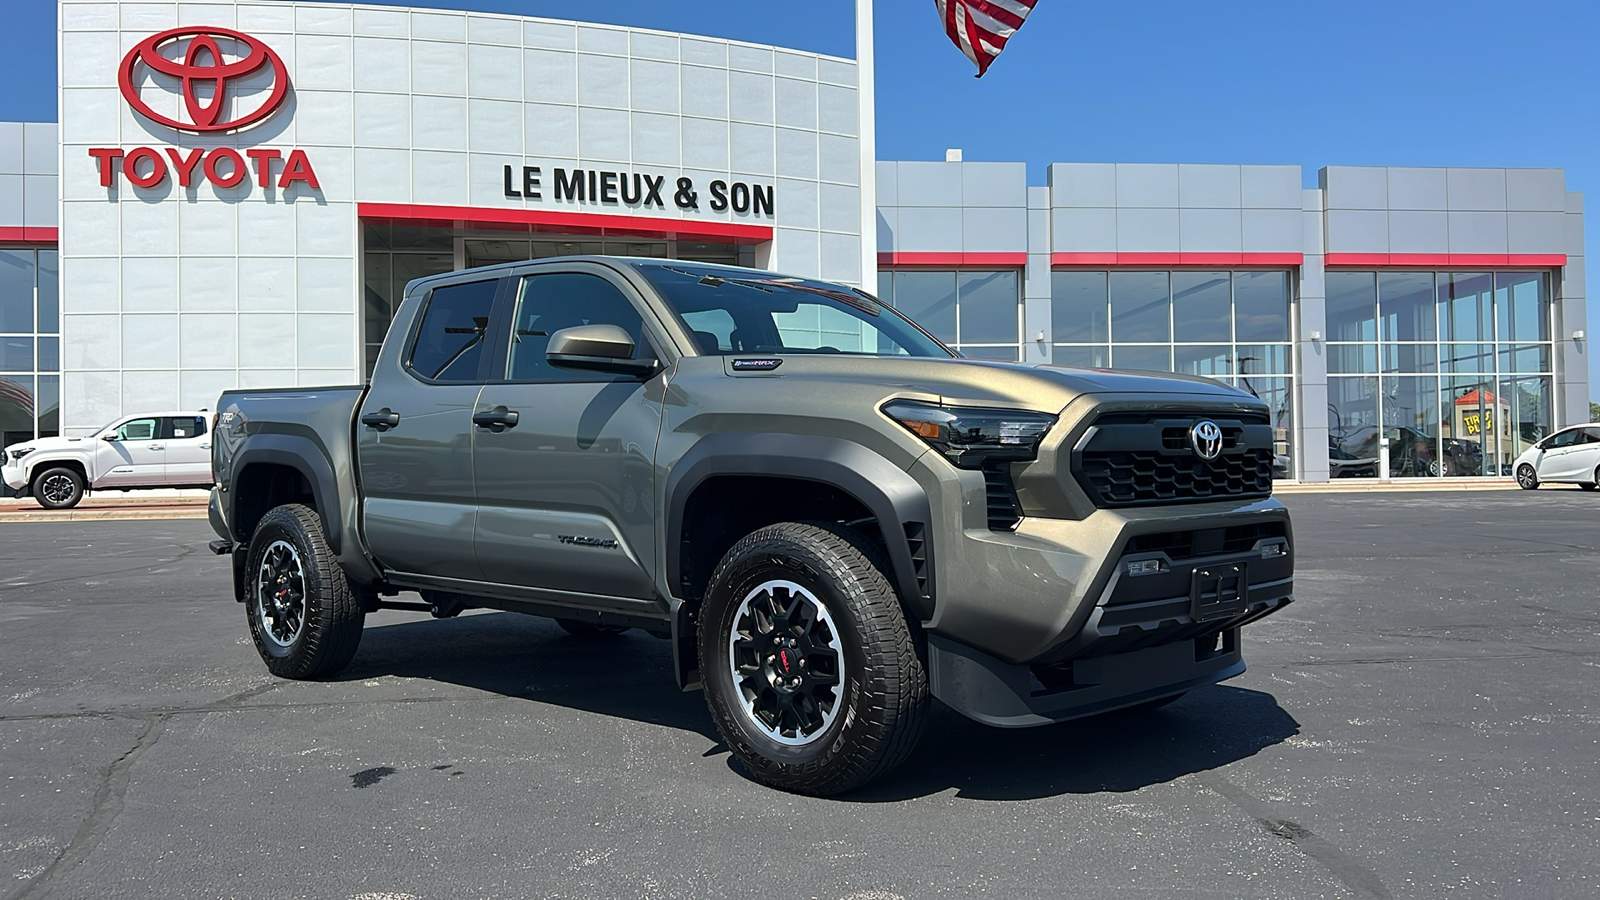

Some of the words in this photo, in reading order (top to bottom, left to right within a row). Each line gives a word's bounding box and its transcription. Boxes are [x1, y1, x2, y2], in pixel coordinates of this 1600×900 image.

[88, 147, 321, 189] TOYOTA
[504, 165, 542, 198] LE
[554, 168, 664, 206] MIEUX
[674, 177, 699, 209] &
[709, 179, 774, 215] SON
[222, 412, 234, 424] TRD
[1463, 410, 1491, 427] TIRS
[1467, 419, 1492, 435] PLS
